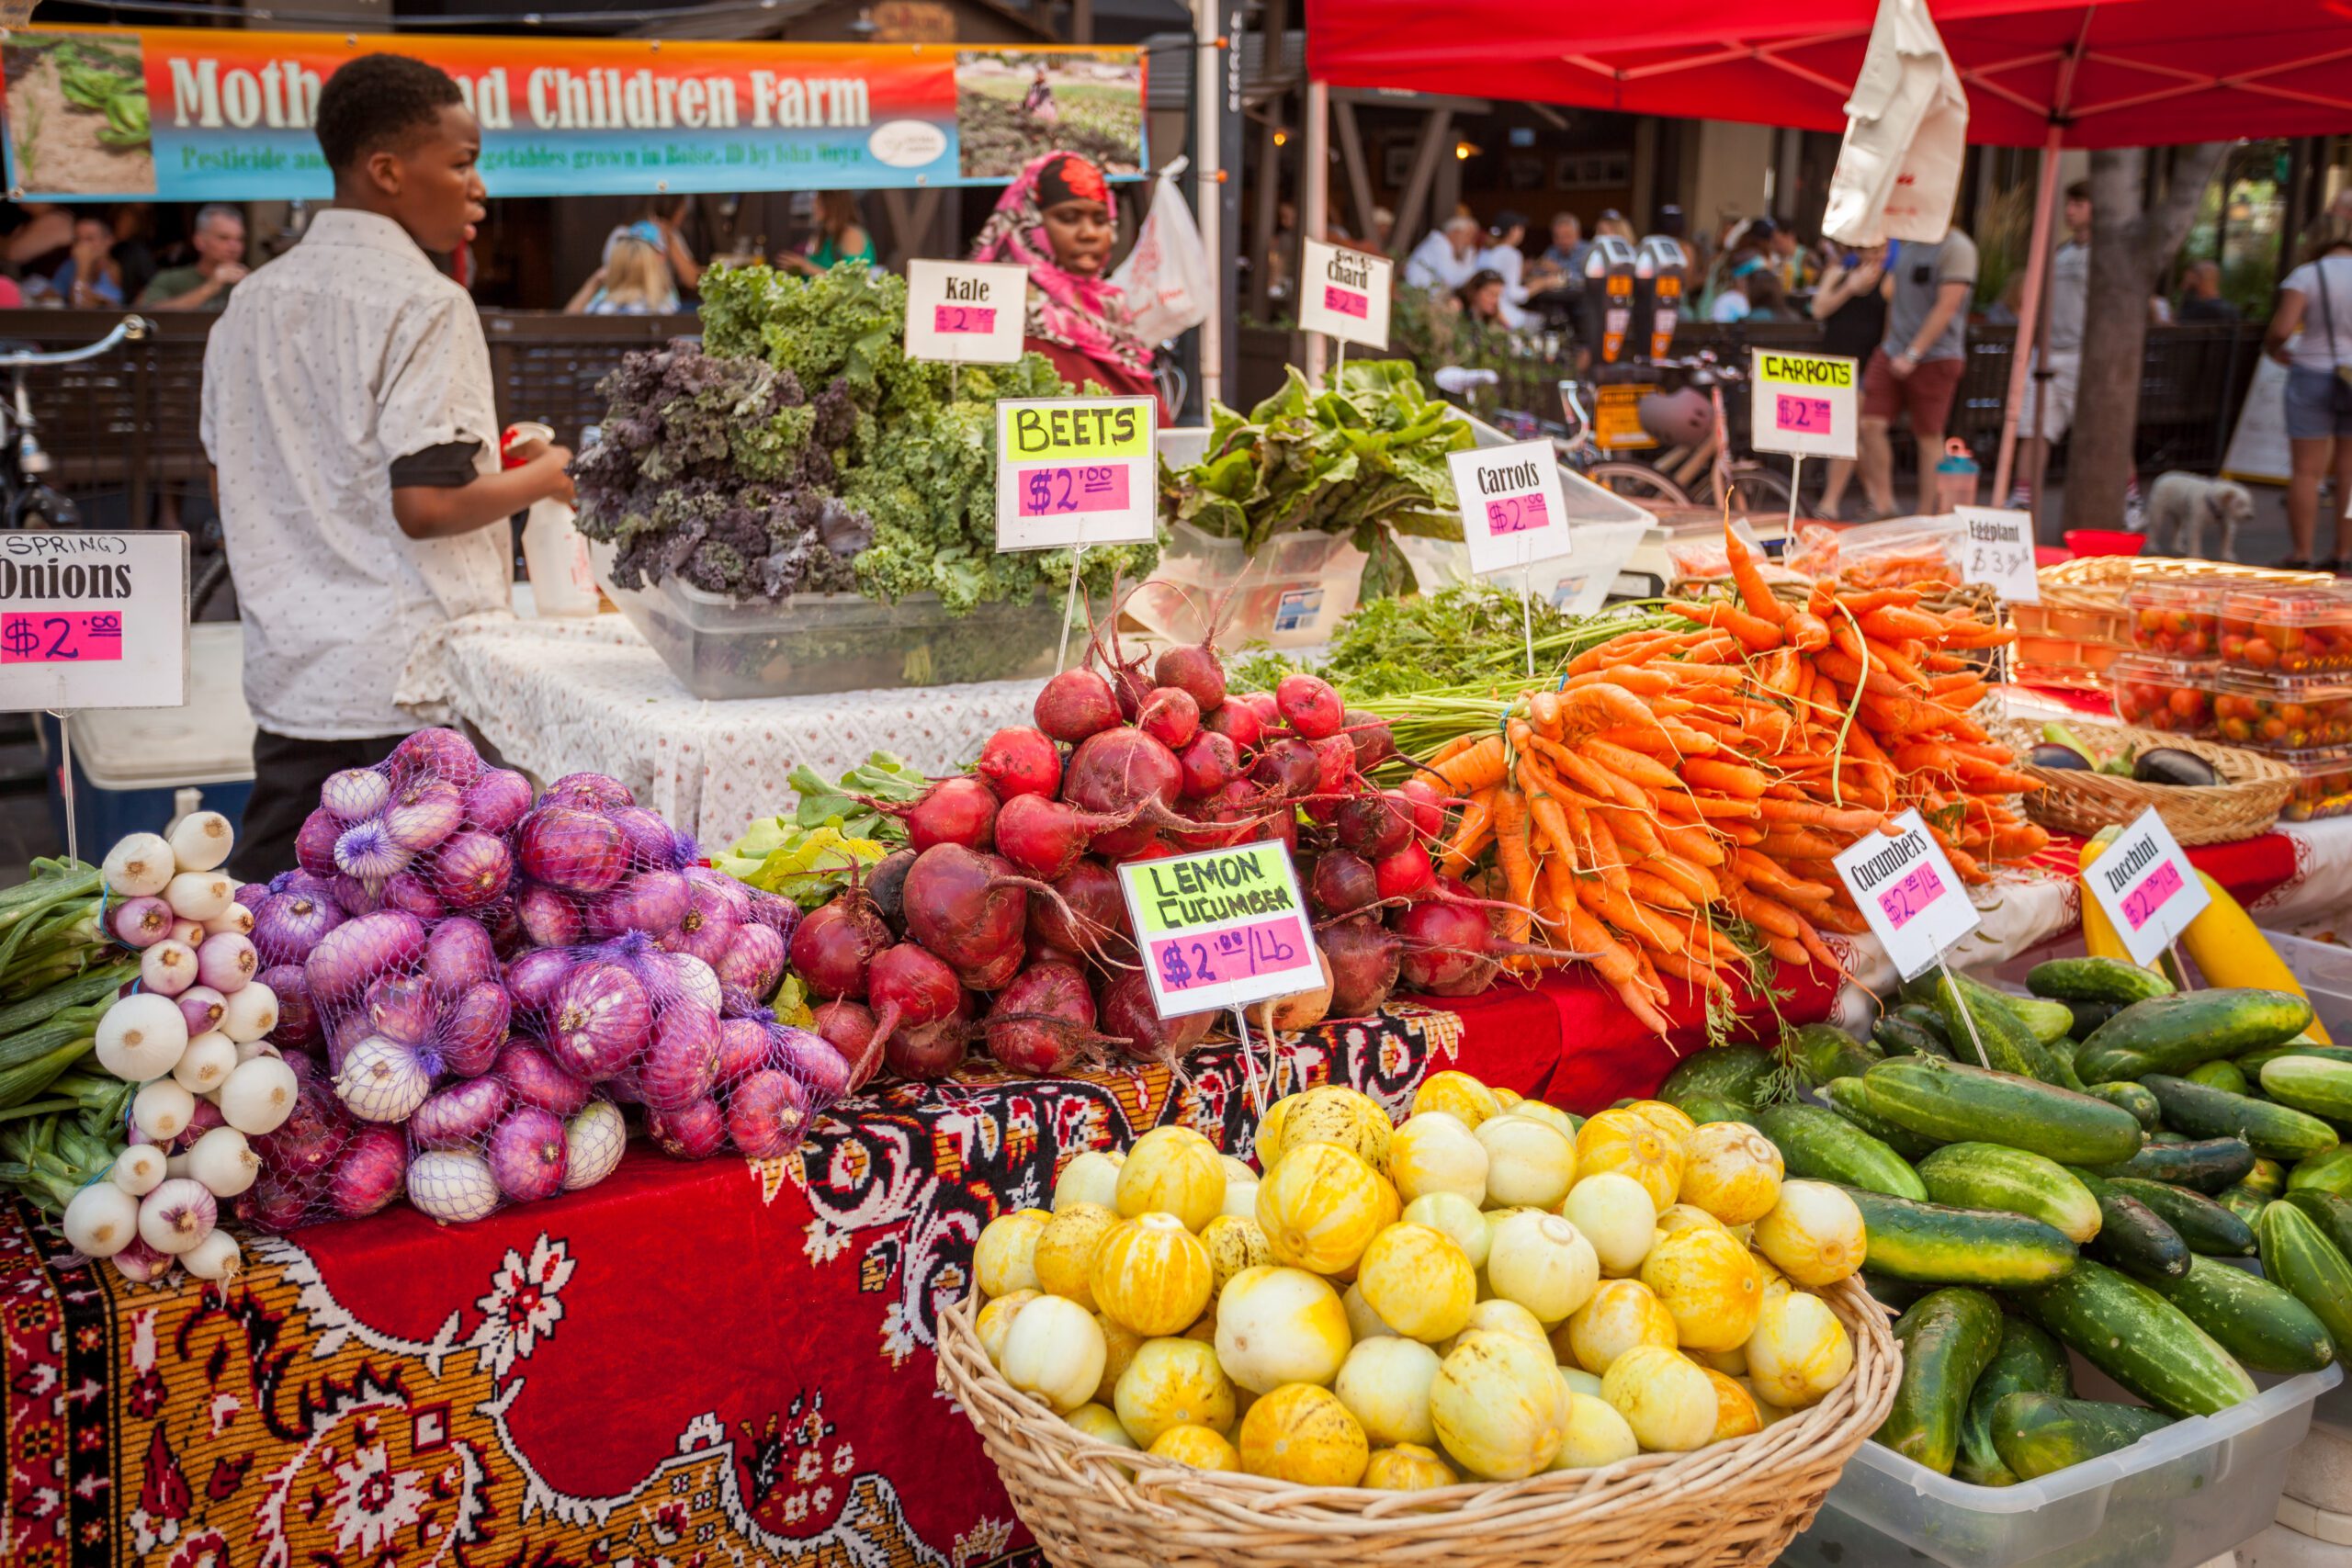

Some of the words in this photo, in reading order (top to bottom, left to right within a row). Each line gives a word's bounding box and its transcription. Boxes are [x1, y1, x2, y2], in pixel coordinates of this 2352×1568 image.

[168, 57, 324, 129] Moth
[527, 66, 739, 130] Children
[749, 70, 871, 128] Farm
[182, 145, 288, 171] Pesticide
[572, 147, 637, 169] grown
[642, 144, 662, 165] in
[749, 143, 770, 168] by
[944, 276, 989, 301] Kale
[1328, 261, 1368, 289] Chard
[1766, 356, 1850, 385] CARROTS
[1016, 407, 1136, 452] BEETS
[1477, 460, 1540, 495] Carrots
[1970, 521, 2020, 544] Eggplant
[0, 558, 132, 599] Onions
[1149, 852, 1265, 897] LEMON
[1850, 829, 1928, 892] Cucumbers
[2104, 832, 2159, 894] Zucchini
[1157, 886, 1295, 929] CUCUMBER
